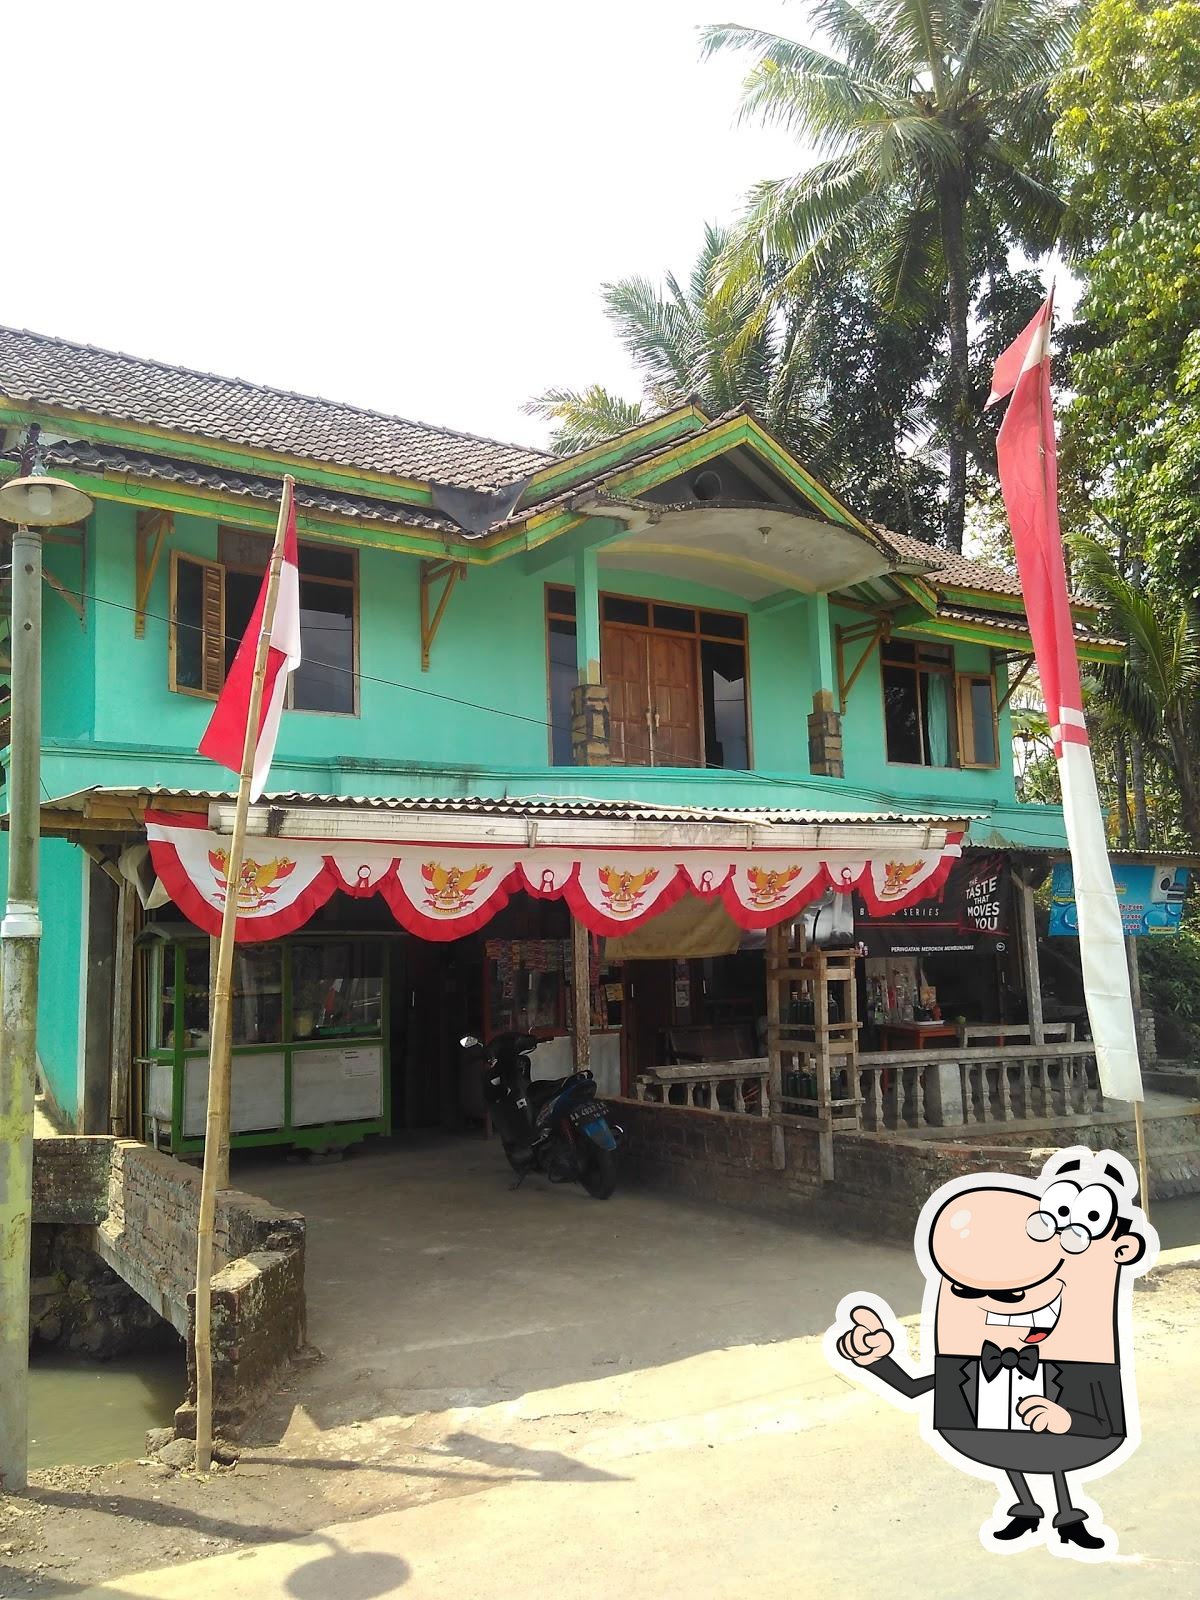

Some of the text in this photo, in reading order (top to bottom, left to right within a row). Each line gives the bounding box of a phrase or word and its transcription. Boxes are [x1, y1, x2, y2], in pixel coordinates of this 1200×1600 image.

[966, 876, 998, 899] TASTE
[969, 877, 978, 887] THE
[974, 895, 990, 904] THAT
[903, 908, 940, 916] SERIES
[968, 902, 1000, 917] MOVES
[975, 917, 998, 931] YOU
